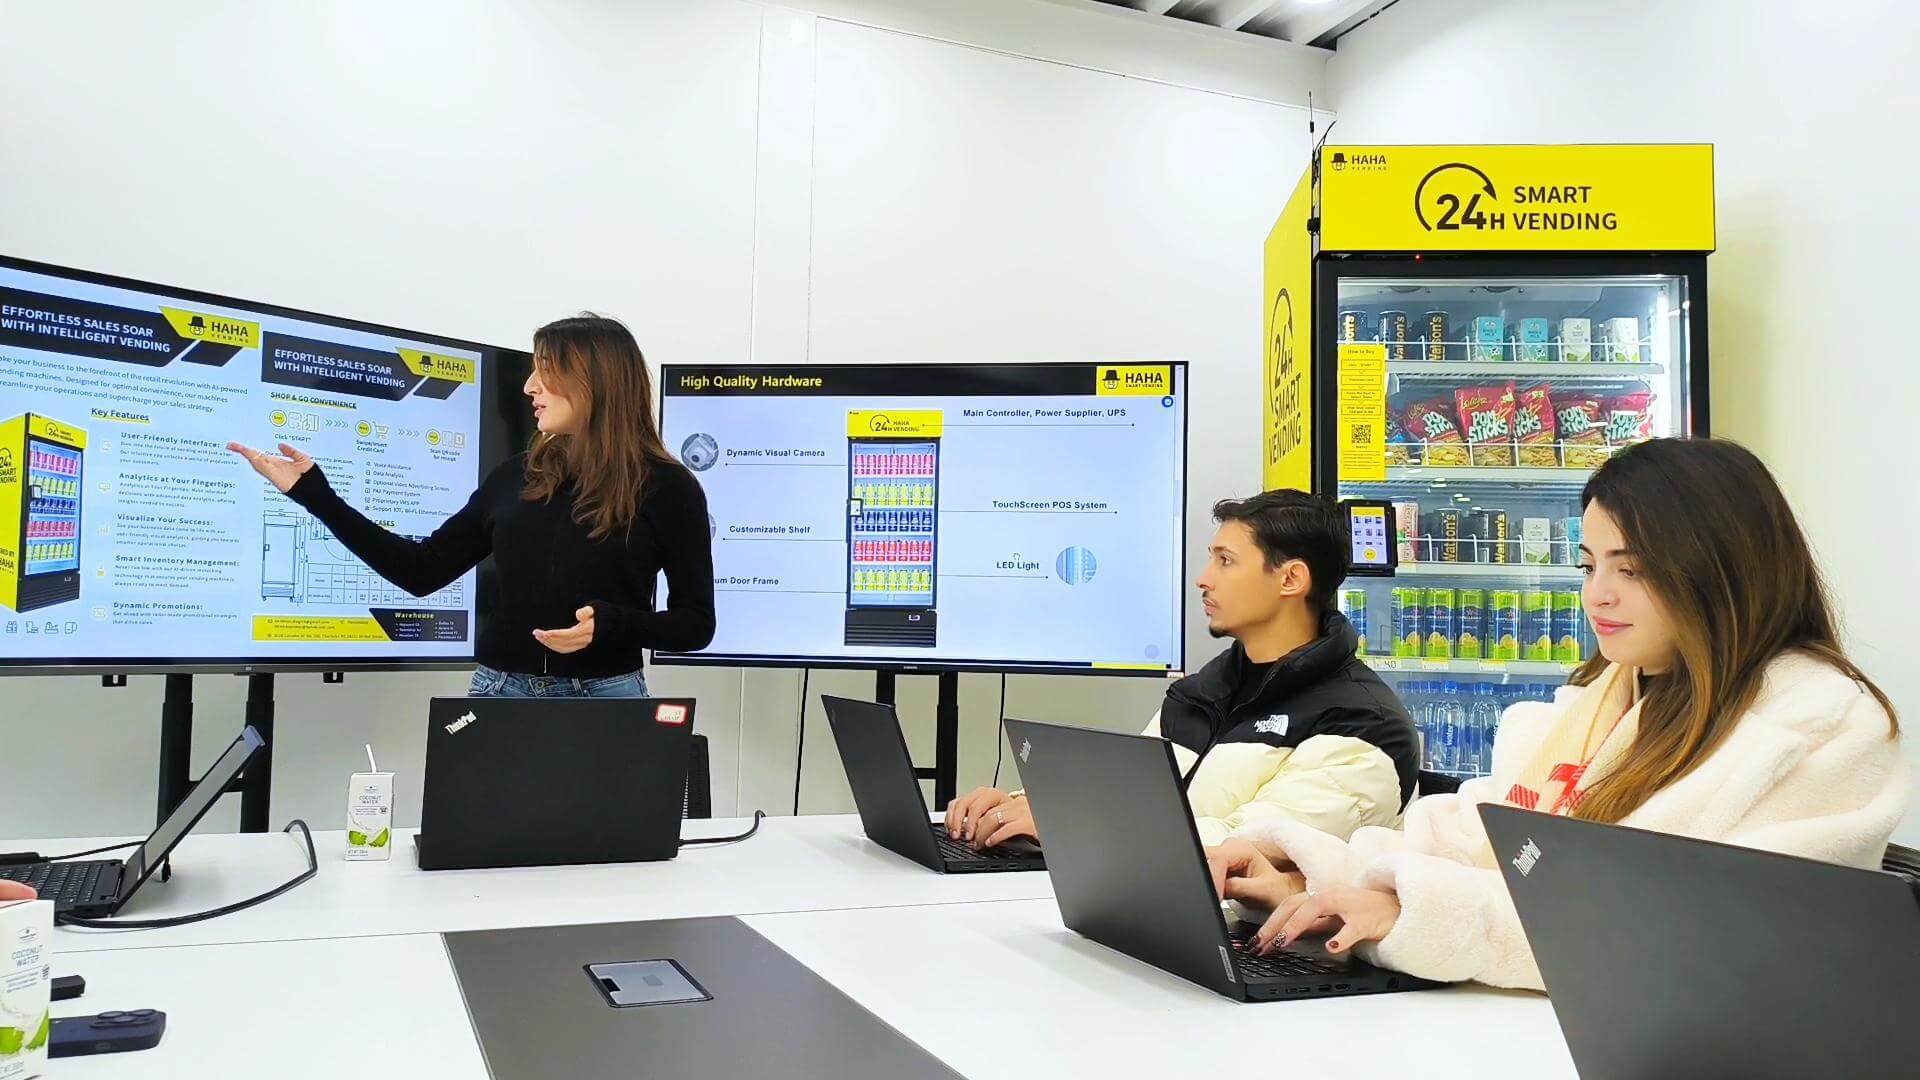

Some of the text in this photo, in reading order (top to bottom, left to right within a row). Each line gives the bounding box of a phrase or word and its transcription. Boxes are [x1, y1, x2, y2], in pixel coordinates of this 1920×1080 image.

[1351, 155, 1386, 165] HAHA
[1513, 185, 1592, 204] SMART
[1436, 193, 1617, 231] 24H VENDING
[2, 305, 154, 338] EFFORTLESS SALES SOAR
[211, 321, 249, 337] HAHA
[1, 318, 171, 353] WITH INTELLIGENT VENDING
[275, 348, 392, 375] EFFORTLESS SALES SOAR
[1274, 324, 1293, 389] 24H
[13, 357, 31, 366] your
[33, 359, 65, 371] business
[76, 366, 88, 374] the
[89, 367, 120, 378] forefront
[142, 375, 161, 383] retail
[161, 378, 196, 388] revolution
[196, 382, 211, 390] with
[274, 360, 406, 388] WITH INTELLIGENT VENDING
[437, 359, 467, 373] HAHA
[680, 375, 823, 390] High Quality Hardware
[1125, 372, 1163, 384] HAHA
[34, 384, 52, 393] your
[53, 386, 93, 398] operations
[93, 391, 108, 399] and
[109, 393, 152, 405] supercharge
[152, 399, 168, 407] your
[169, 401, 186, 409] sales
[65, 376, 99, 388] Designed
[112, 383, 139, 393] optimal
[197, 394, 229, 403] machines
[270, 391, 291, 400] SHOP
[298, 395, 309, 403] GO
[310, 397, 357, 410] CONVENIENCE
[1274, 372, 1301, 429] SMART
[91, 407, 150, 421] Key Features
[963, 409, 1126, 419] Main Controller, Power Supplier, UPS
[121, 432, 178, 445] User-Friendly
[180, 438, 220, 448] Interface:
[1268, 412, 1302, 467] VENDING
[726, 448, 825, 459] Dynamic Visual Camera
[119, 472, 158, 483] Analytics
[192, 479, 236, 489] Fingertips:
[993, 500, 1107, 511] TouchScreen POS System
[117, 513, 155, 522] Visualize
[179, 517, 214, 526] Success:
[729, 525, 811, 534] Customizable Shelf
[115, 554, 240, 567] Smart Inventory Management:
[996, 561, 1040, 571] LED Light
[730, 576, 751, 585] Door
[752, 576, 779, 585] Frame
[113, 602, 203, 610] Dynamic Promotions:
